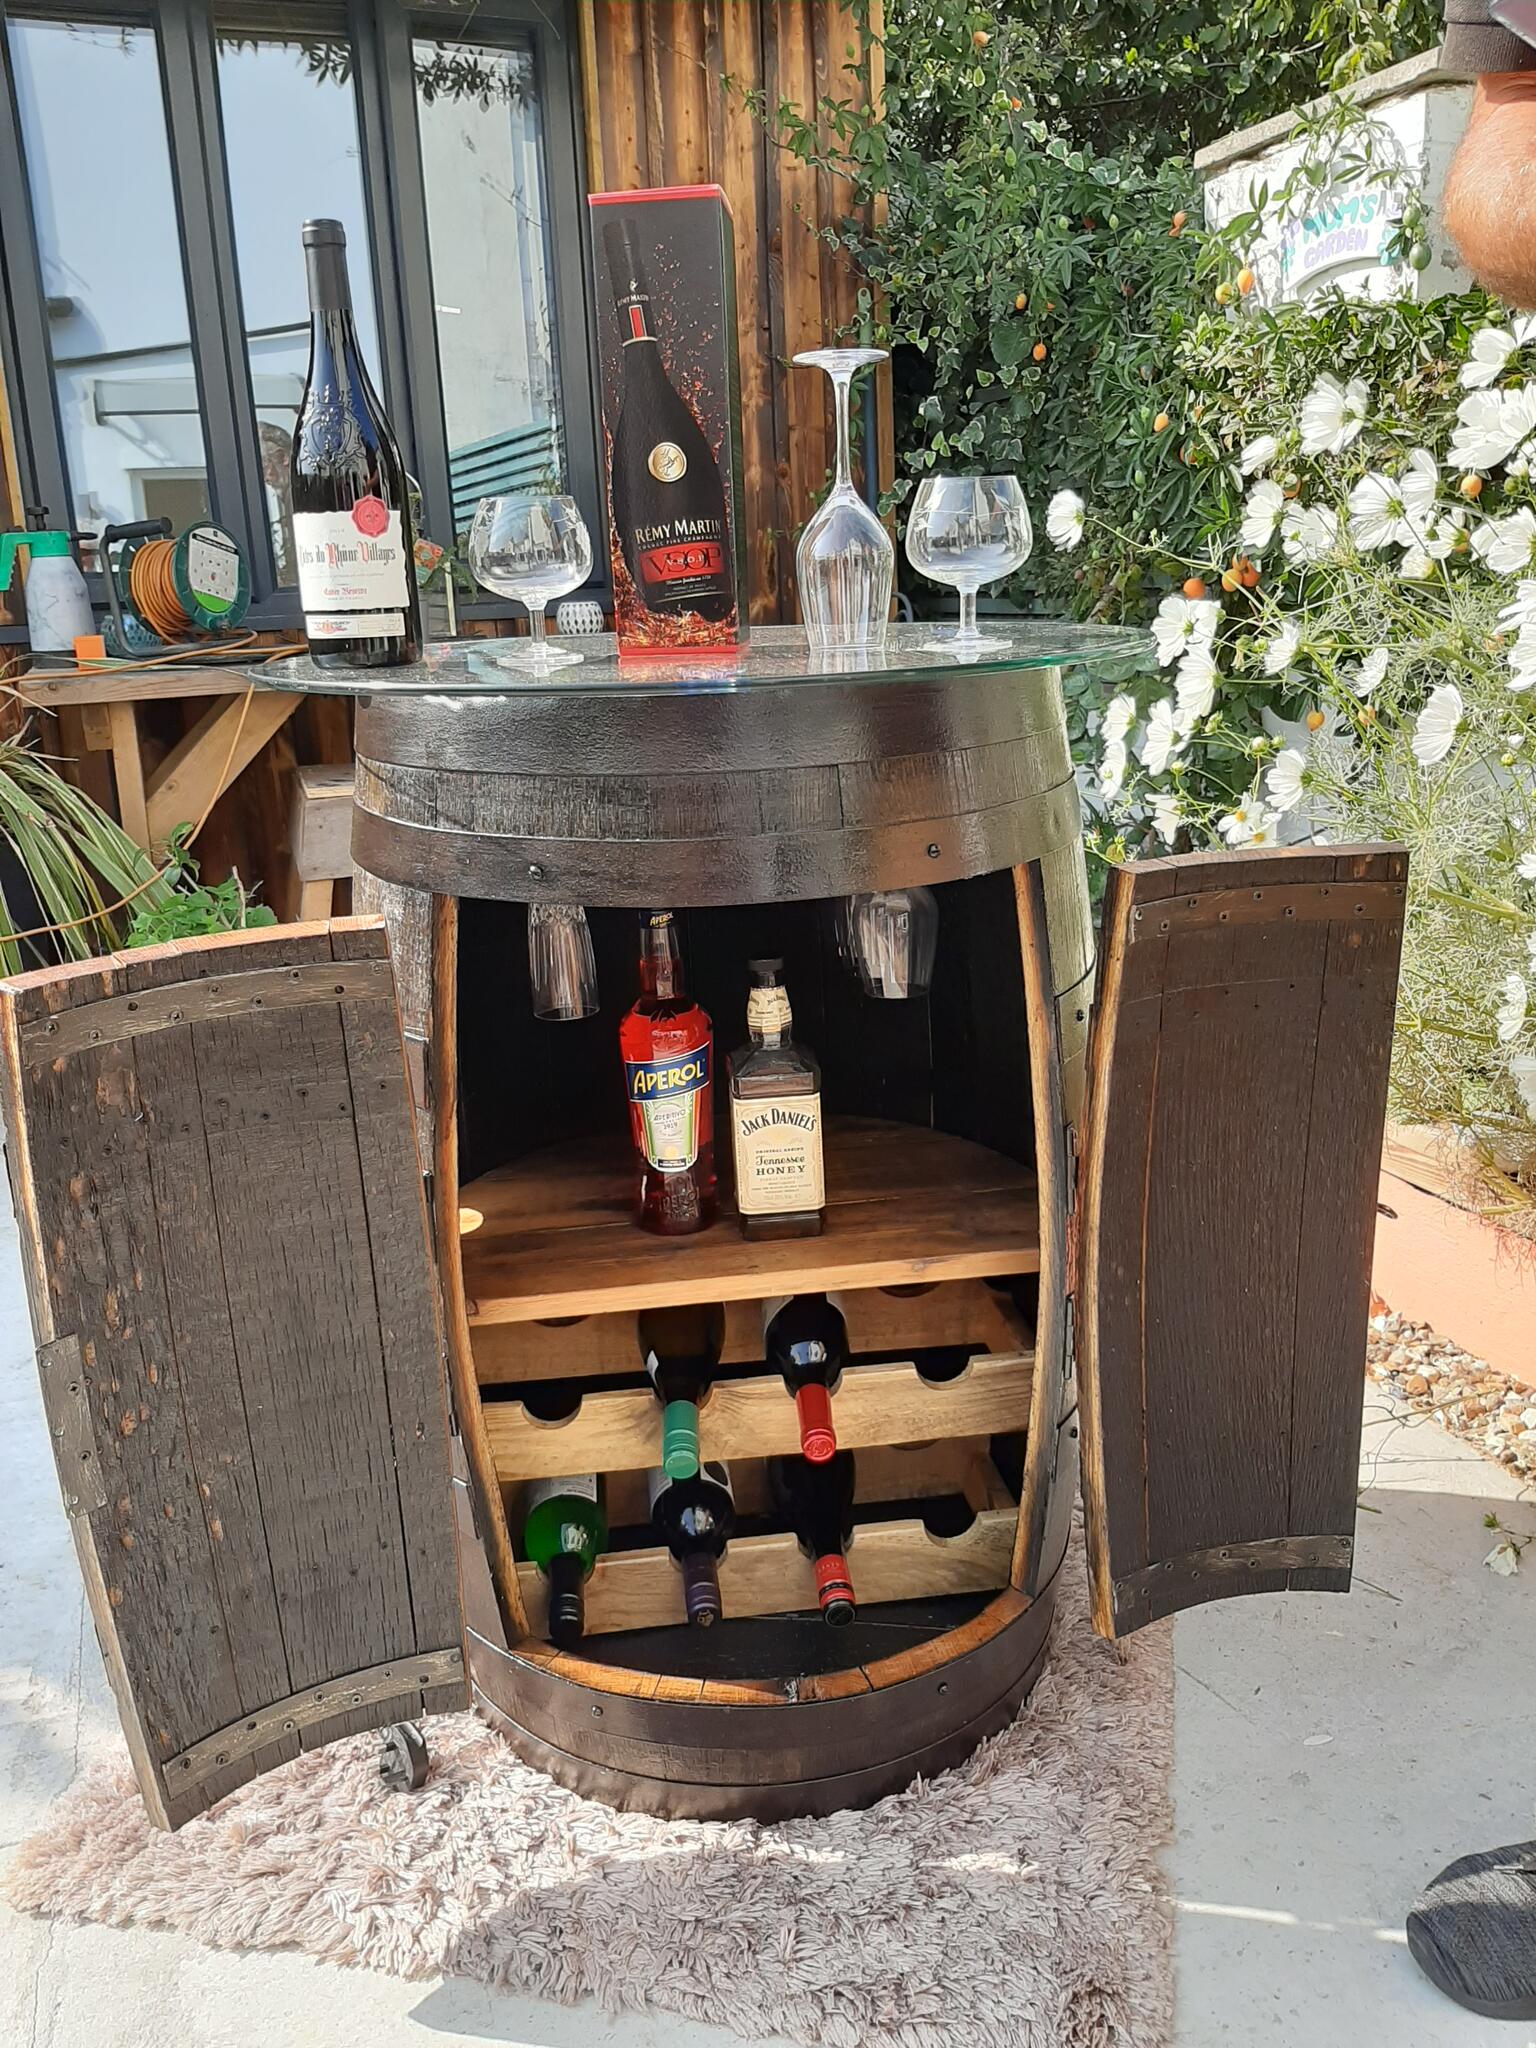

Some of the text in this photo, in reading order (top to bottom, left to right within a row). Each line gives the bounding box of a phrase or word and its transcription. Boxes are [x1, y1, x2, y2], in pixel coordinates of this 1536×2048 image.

[1303, 227, 1368, 269] GARDEN
[635, 519, 721, 545] RÉMY MARTIN
[634, 1060, 705, 1095] APEROL
[741, 1108, 818, 1137] JACK DANIEL'S
[755, 1155, 805, 1167] Tennessee
[756, 1165, 807, 1176] HONEY
